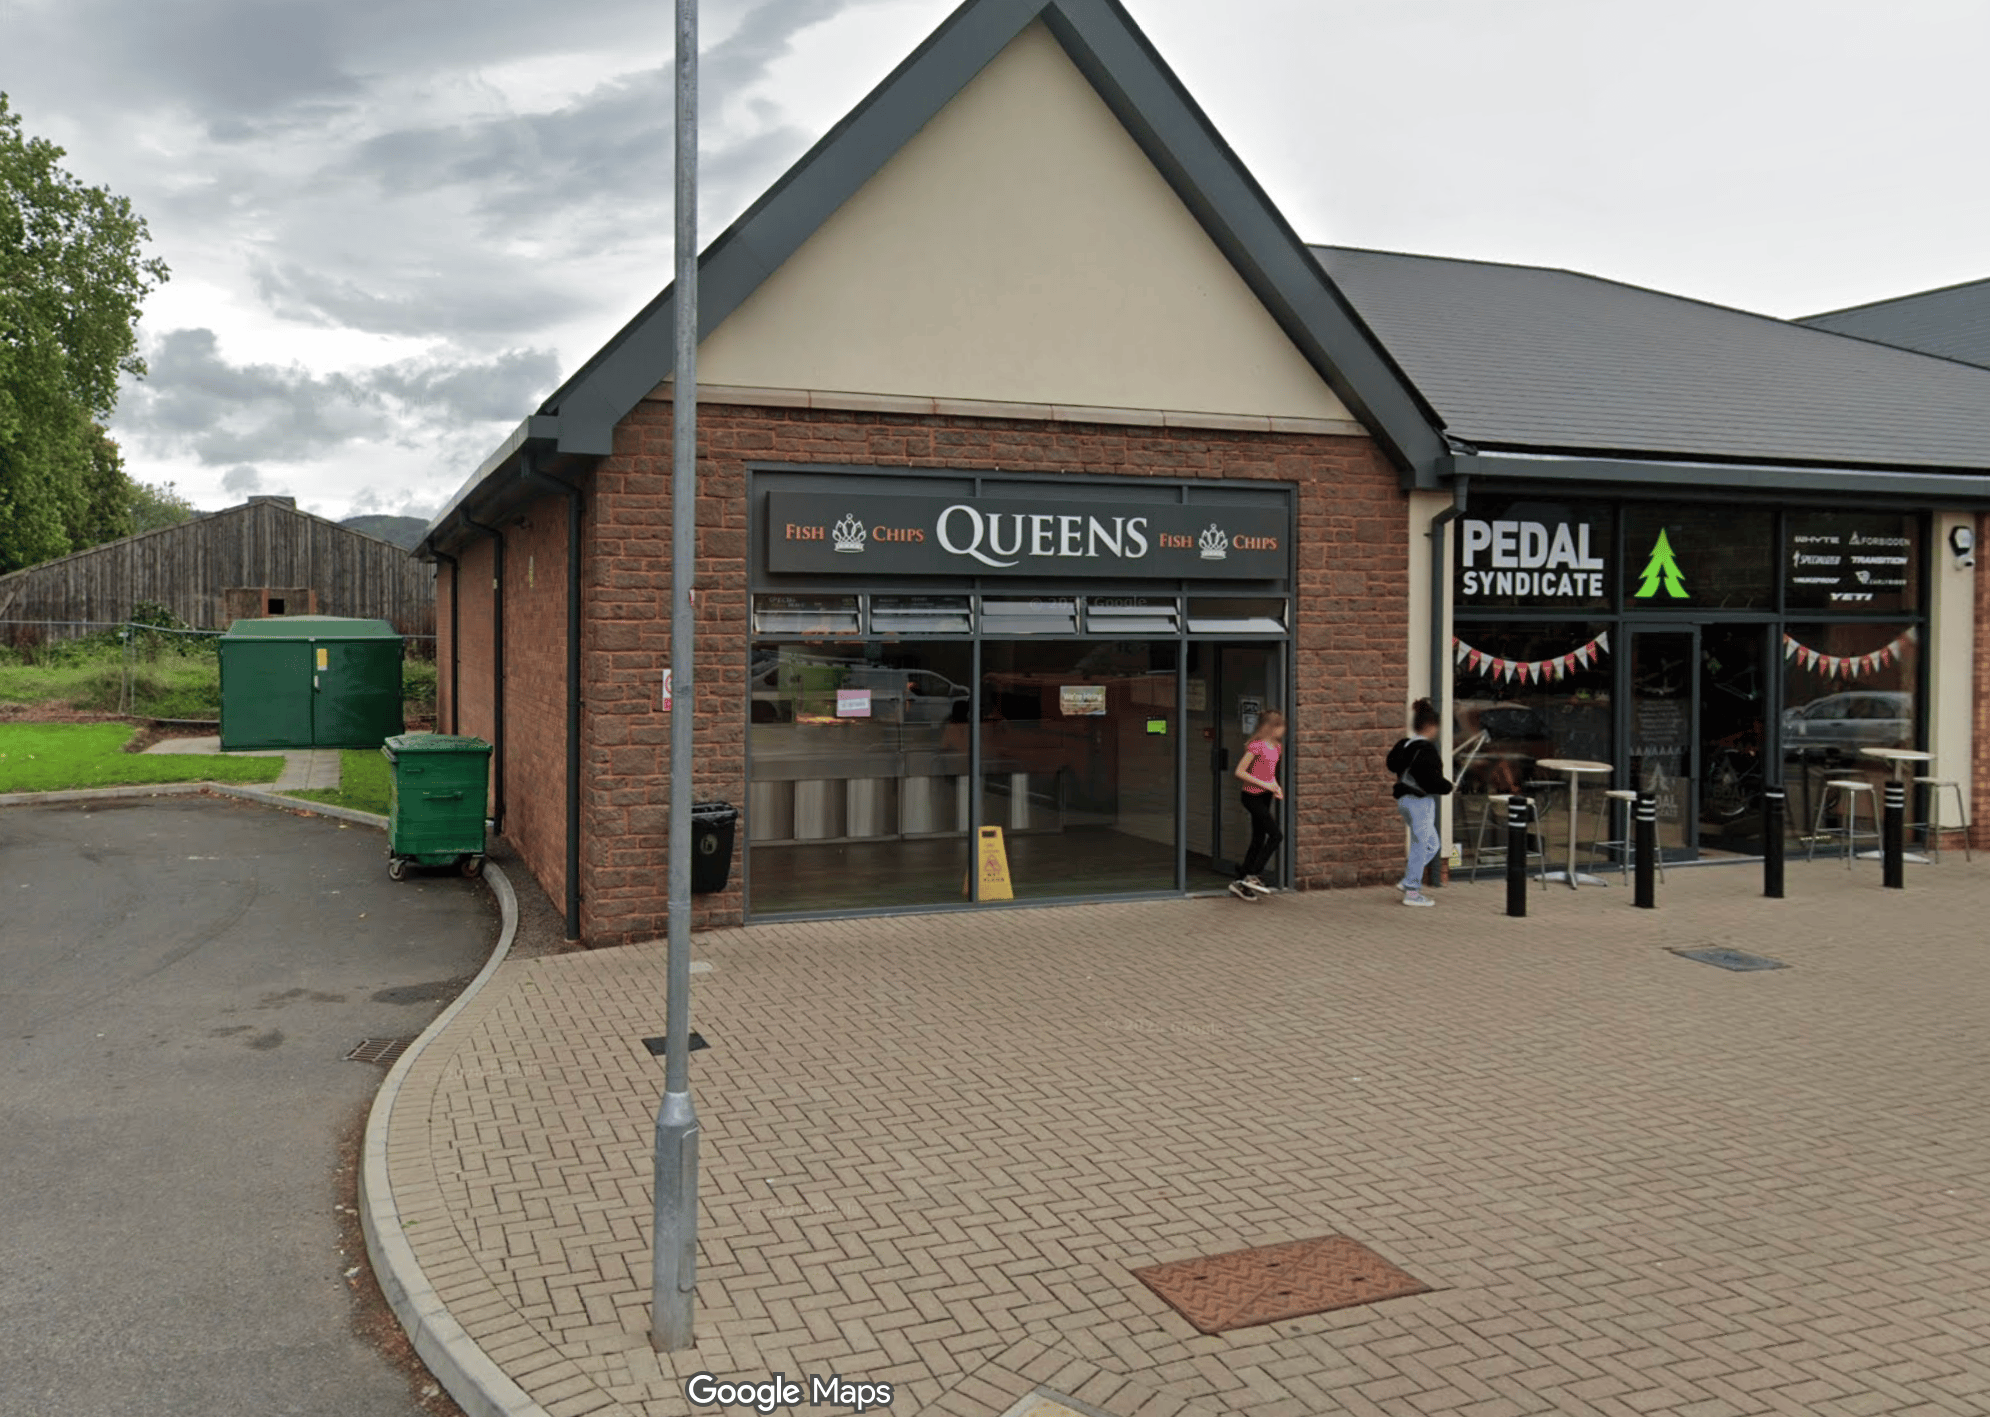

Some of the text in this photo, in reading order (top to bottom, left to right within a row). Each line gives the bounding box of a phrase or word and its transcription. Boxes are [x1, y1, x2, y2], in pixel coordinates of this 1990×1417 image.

[936, 504, 1148, 568] QUEENS
[1462, 519, 1604, 570] PEDAL
[1794, 535, 1840, 544] WHYTE
[1850, 555, 1909, 565] TRANSITION
[1462, 571, 1604, 598] SYNDICATE
[1830, 592, 1874, 601] YETI
